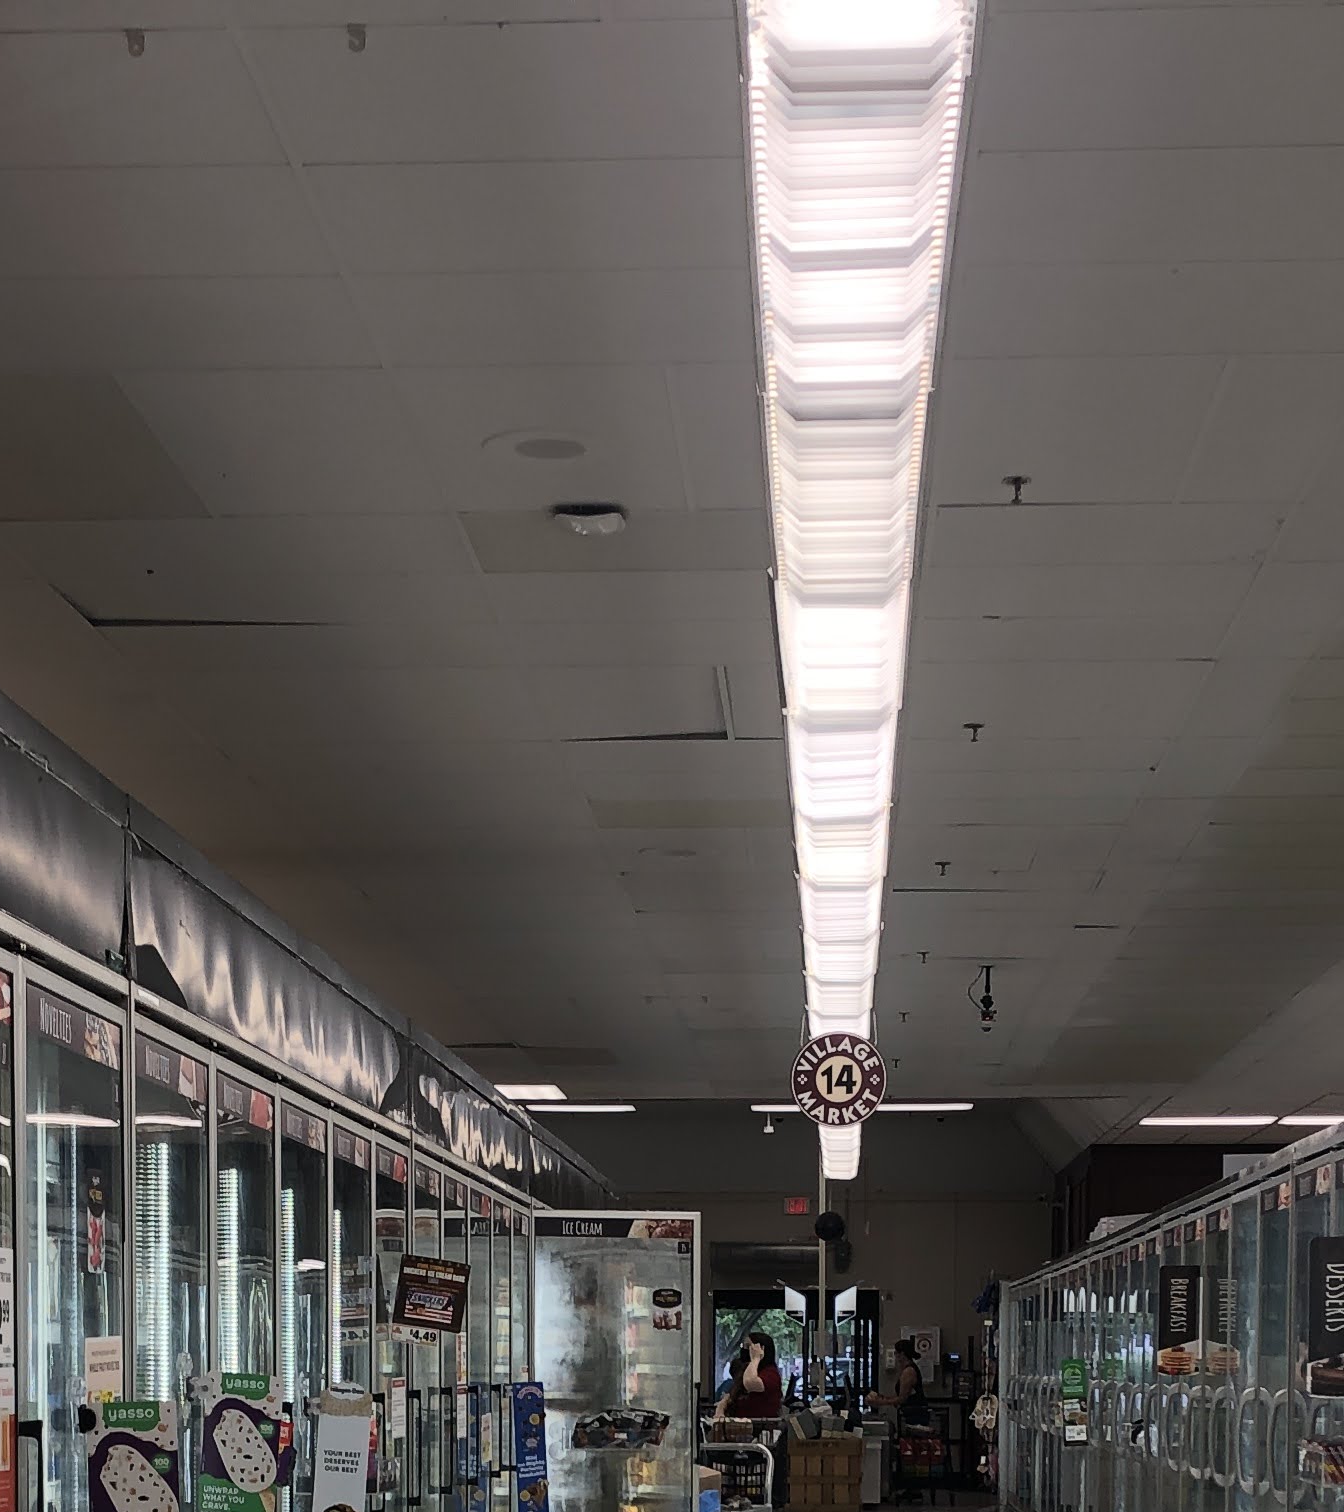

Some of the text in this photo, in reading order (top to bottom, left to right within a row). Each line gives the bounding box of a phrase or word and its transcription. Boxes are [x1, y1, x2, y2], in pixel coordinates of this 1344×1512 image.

[39, 997, 73, 1045] NOVELTIES
[797, 1036, 880, 1073] VILLAGE
[820, 1064, 857, 1096] 14
[798, 1088, 879, 1125] MARKET
[561, 1219, 603, 1237] ICE CREAM
[1170, 1278, 1190, 1333] BREAKFAST
[225, 1376, 266, 1390] yasso
[108, 1407, 155, 1422] yasso
[323, 1449, 361, 1459] YOUR BEST
[323, 1457, 360, 1467] DESERVES
[324, 1465, 358, 1474] OUR BEST
[203, 1485, 240, 1496] UNWRAP
[202, 1493, 246, 1505] WHAT YOU
[201, 1501, 232, 1512] CRAVE.
